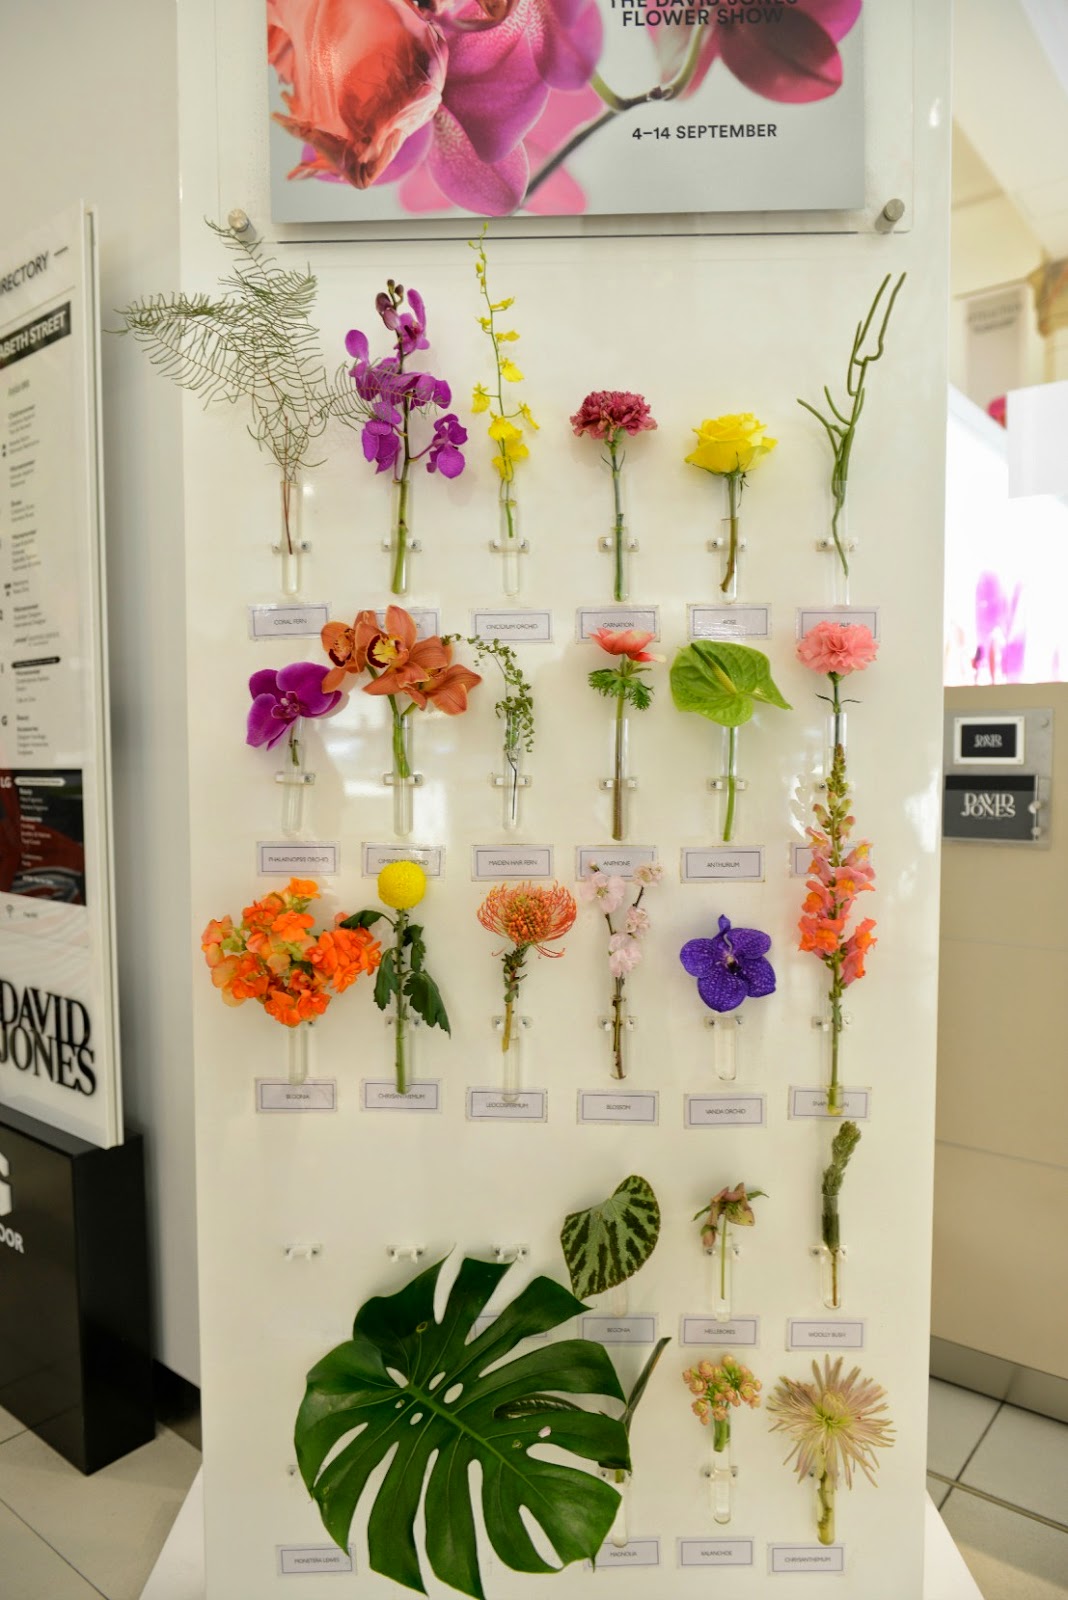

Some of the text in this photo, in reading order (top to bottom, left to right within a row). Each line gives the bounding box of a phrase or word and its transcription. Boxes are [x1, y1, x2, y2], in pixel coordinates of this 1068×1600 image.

[623, 8, 784, 26] FLOWER SHOW
[676, 124, 777, 138] SEPTEMBER
[0, 310, 66, 359] BETH STREET
[963, 793, 1015, 808] DAVID
[961, 803, 1016, 818] JONES
[0, 980, 91, 1048] DAVID
[0, 1024, 96, 1096] JONES
